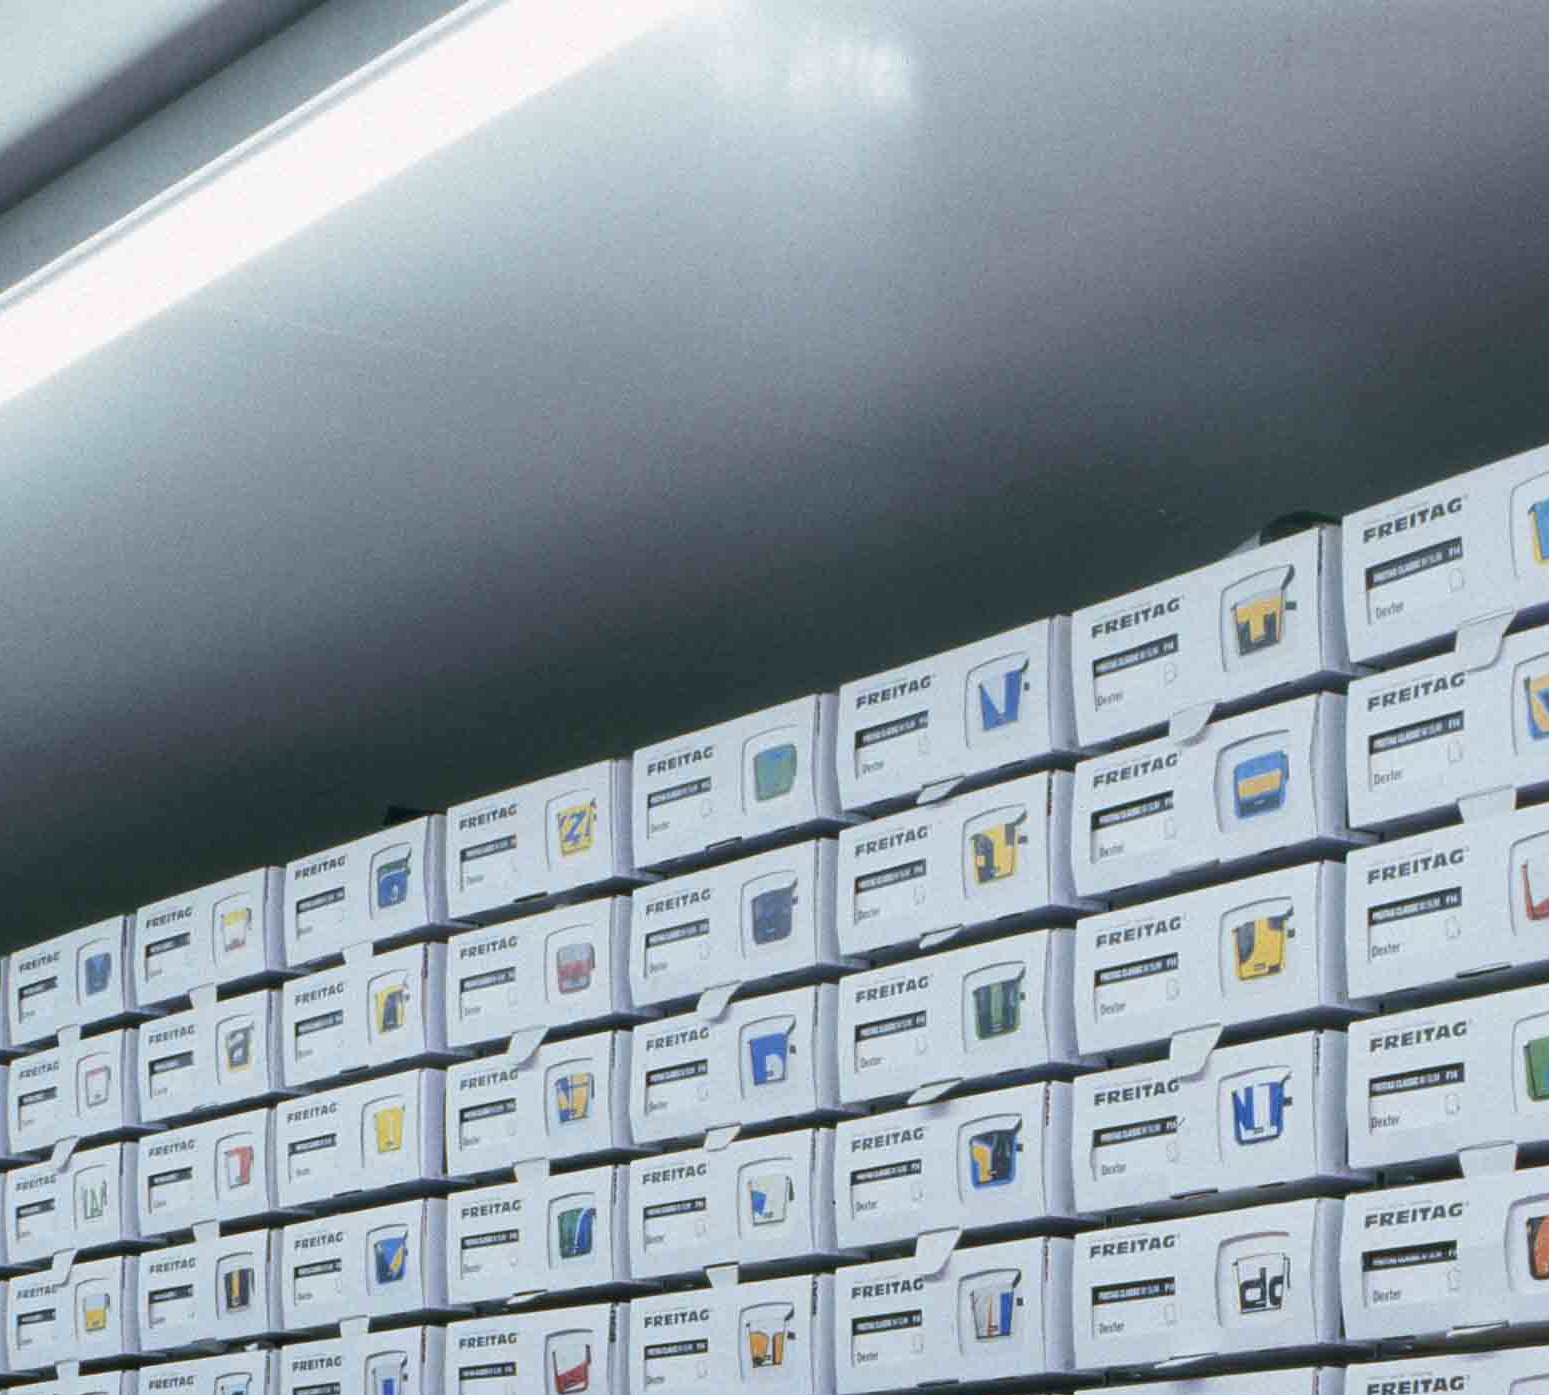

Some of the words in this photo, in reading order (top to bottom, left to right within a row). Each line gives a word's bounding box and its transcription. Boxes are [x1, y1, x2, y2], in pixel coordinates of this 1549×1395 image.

[1364, 498, 1461, 543] FREITAG
[1093, 753, 1177, 787] FREITAG
[855, 826, 927, 856] FREITAG
[1370, 1021, 1466, 1052] FREITAG
